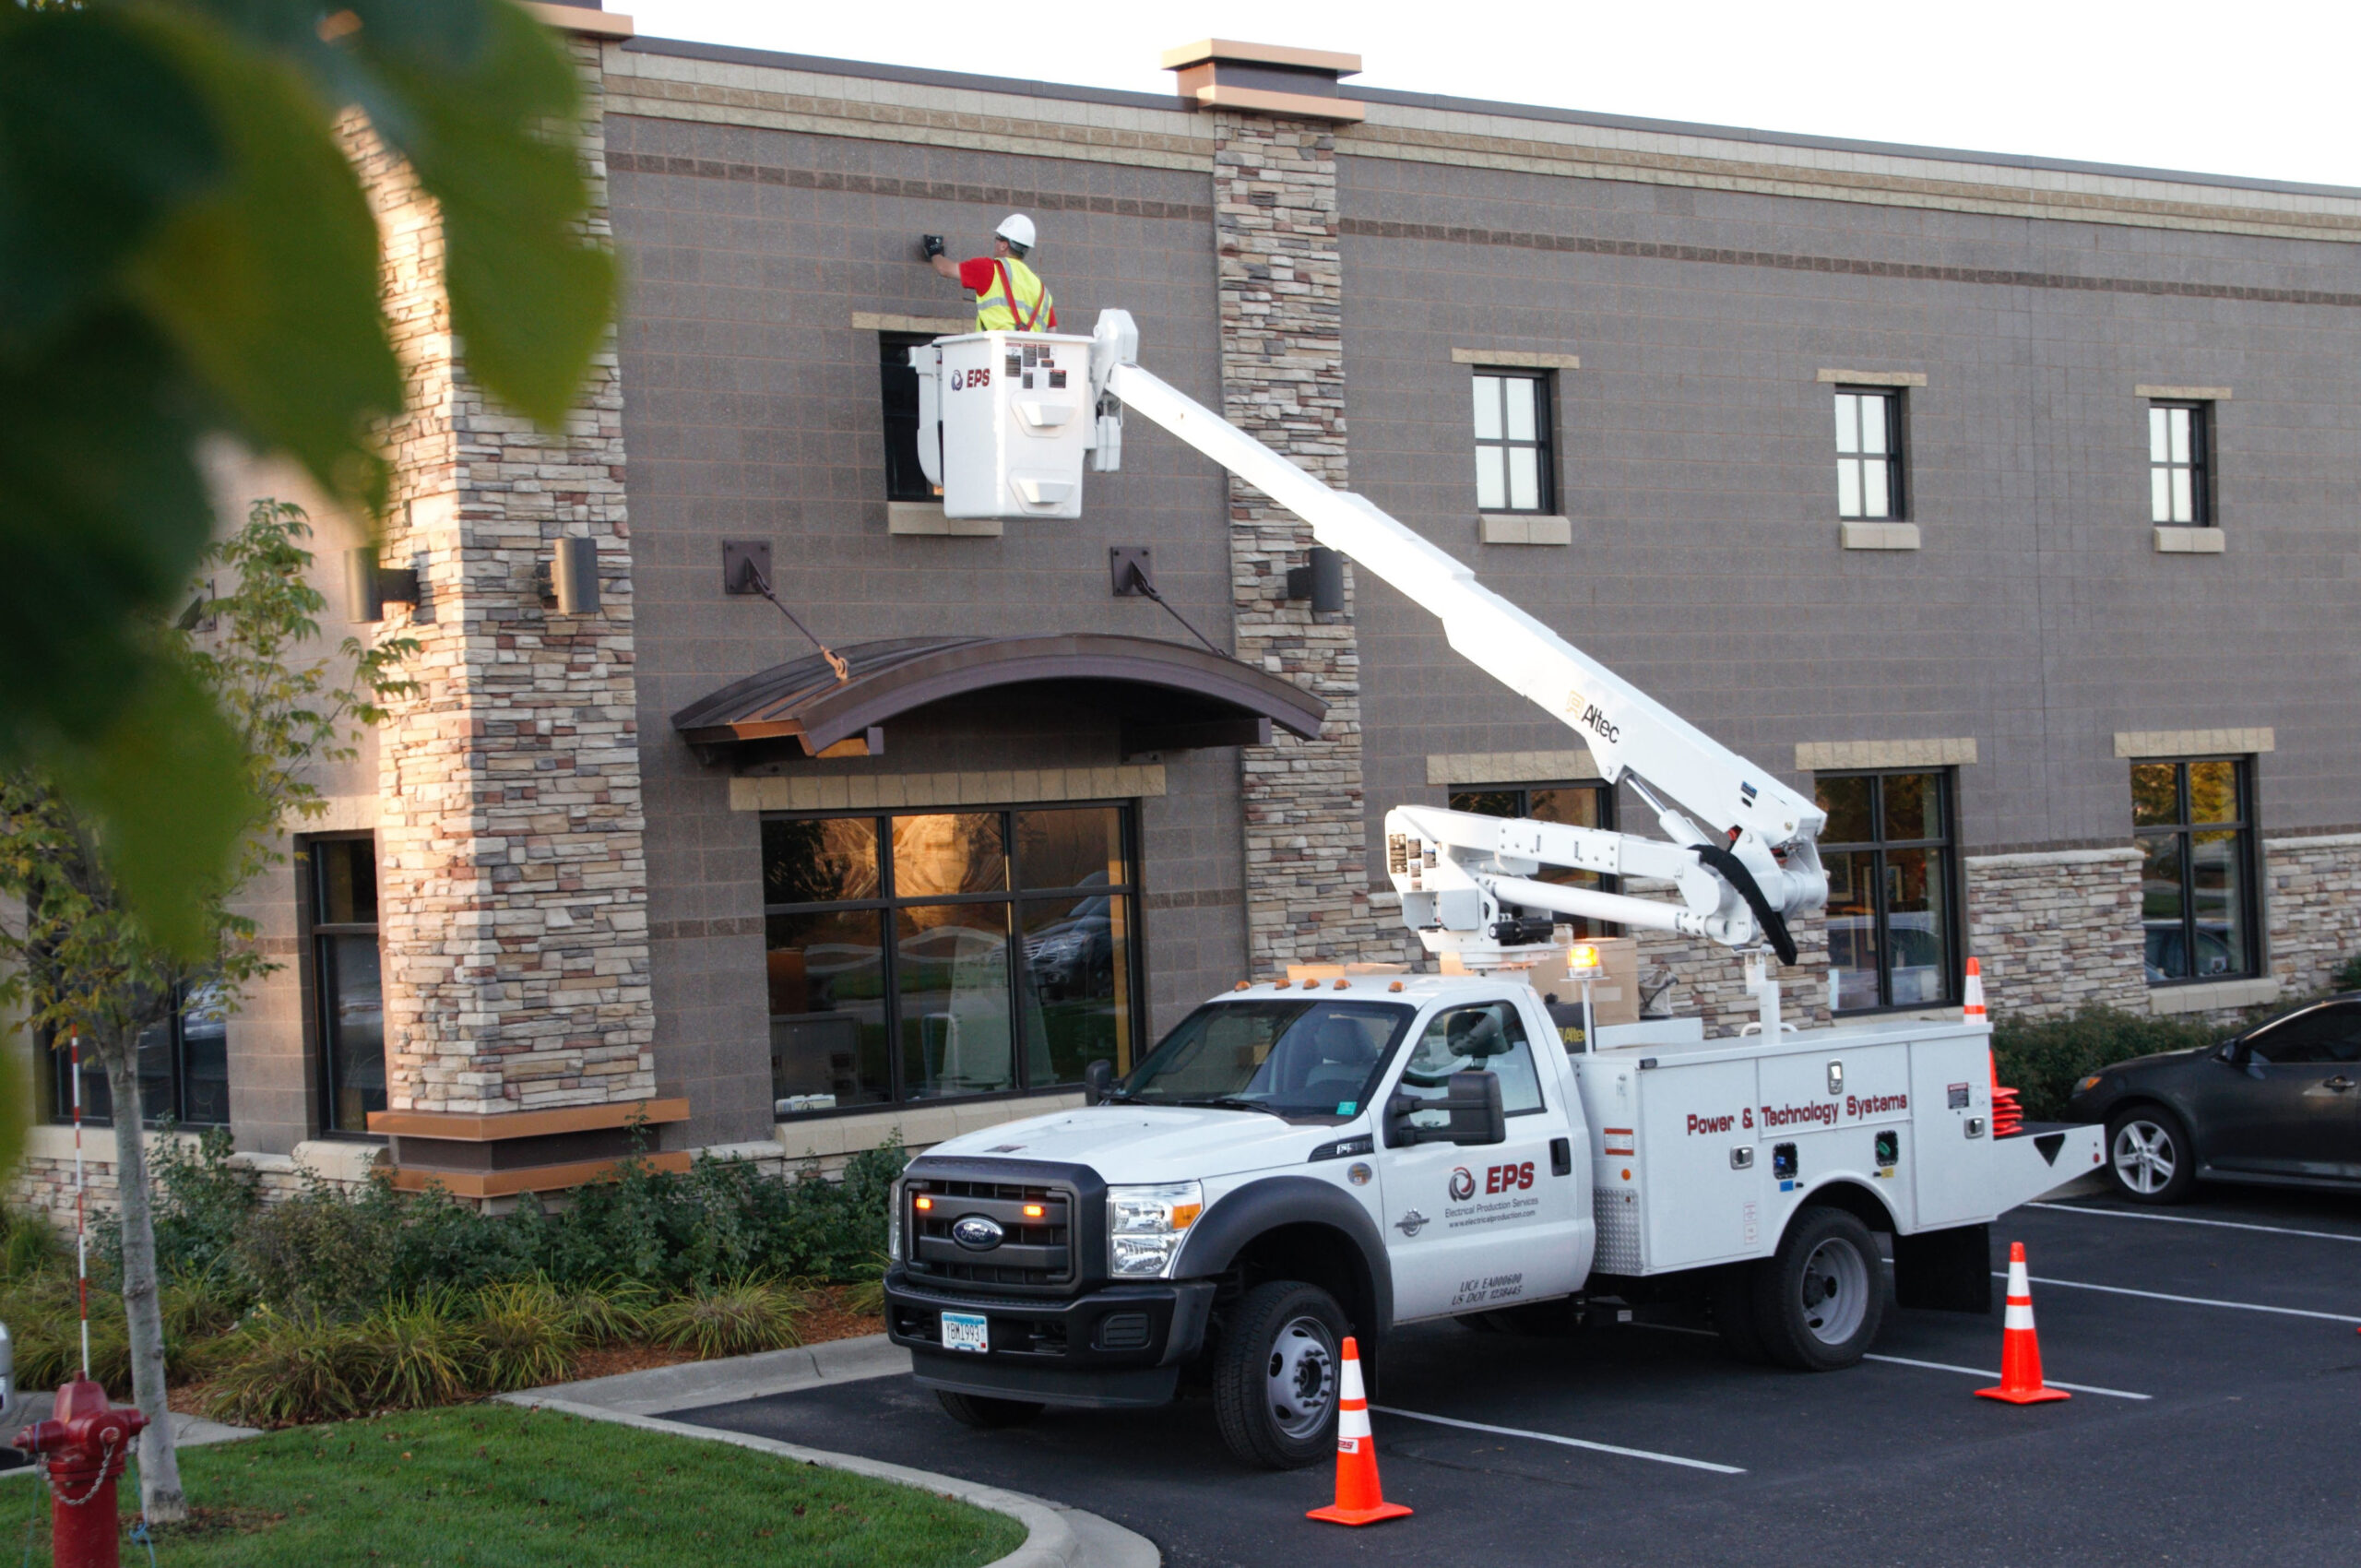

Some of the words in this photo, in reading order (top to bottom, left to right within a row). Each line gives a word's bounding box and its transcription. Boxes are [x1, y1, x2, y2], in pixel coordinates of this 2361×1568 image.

[967, 368, 991, 388] EPS
[1581, 704, 1620, 743] Altec
[1564, 1027, 1585, 1043] Alte
[1687, 1114, 1735, 1135] Power
[1742, 1108, 1754, 1129] &
[1761, 1100, 1839, 1127] Technology
[1846, 1094, 1907, 1120] Systems
[1485, 1161, 1535, 1194] EPS
[1445, 1205, 1475, 1218] Electrical
[1477, 1200, 1511, 1213] Production
[1513, 1197, 1539, 1208] Services
[1449, 1209, 1536, 1229] www.electricalproduction.com
[1452, 1294, 1465, 1306] US
[1465, 1290, 1487, 1303] DOT
